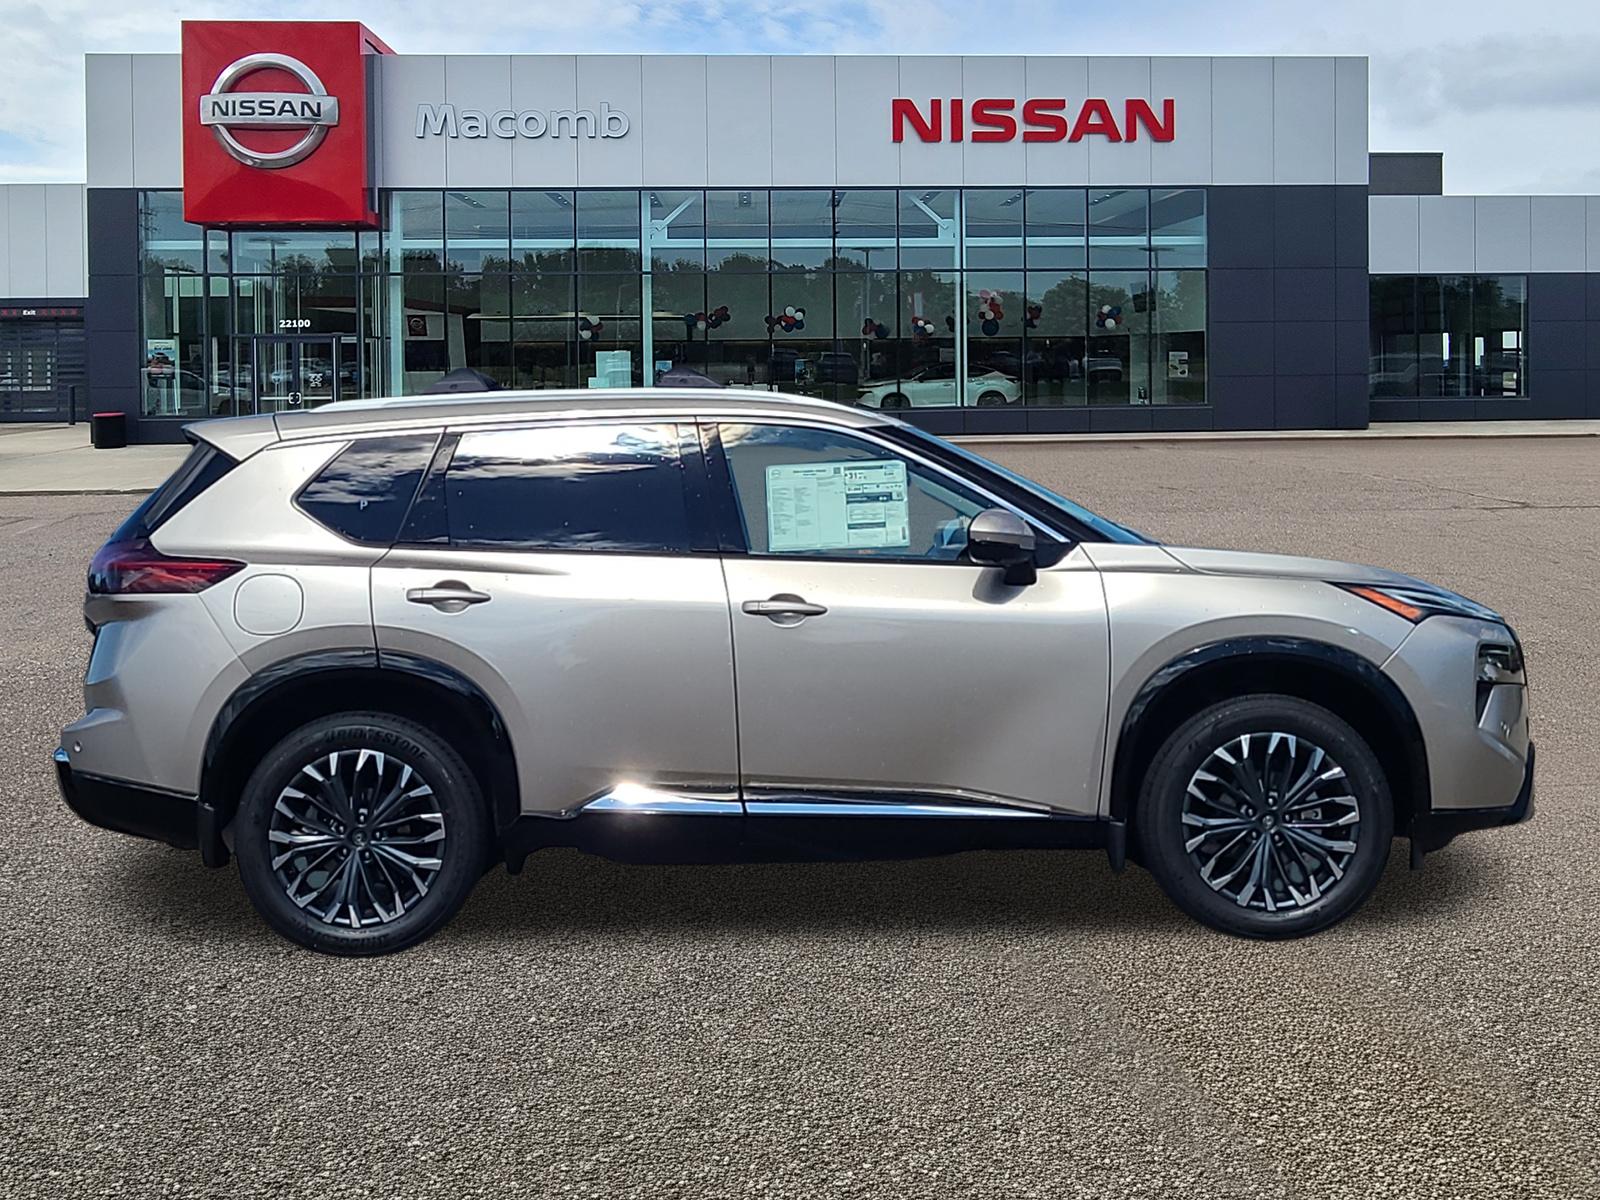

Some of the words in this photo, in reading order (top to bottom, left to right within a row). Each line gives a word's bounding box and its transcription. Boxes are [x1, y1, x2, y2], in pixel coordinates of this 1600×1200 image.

[211, 100, 321, 118] NISSAN
[415, 102, 630, 138] Macomb
[892, 98, 1175, 142] NISSAN
[279, 319, 311, 328] 22100
